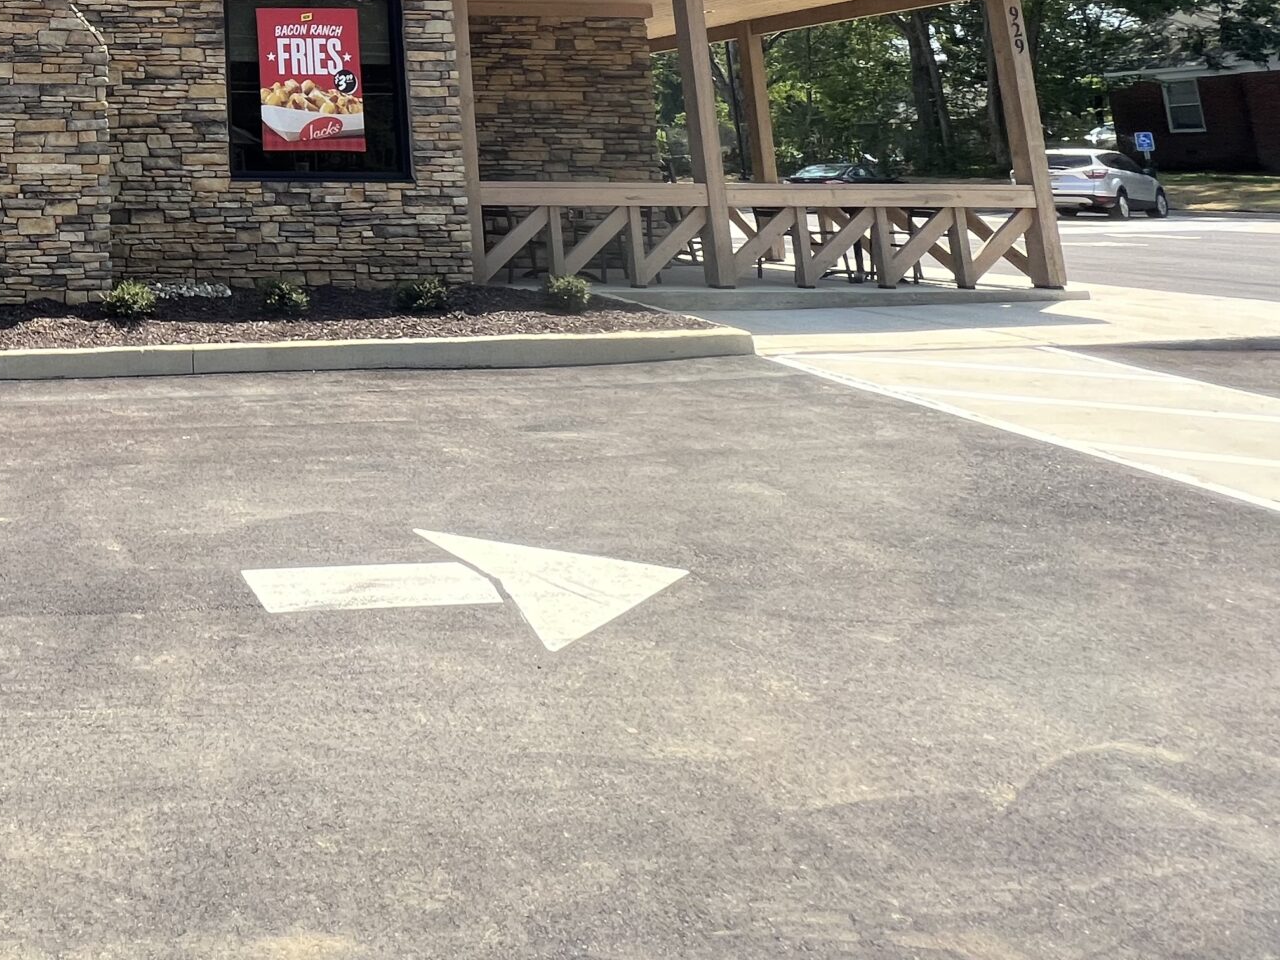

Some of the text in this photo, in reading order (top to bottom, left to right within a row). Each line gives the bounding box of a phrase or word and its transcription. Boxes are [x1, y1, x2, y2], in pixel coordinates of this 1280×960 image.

[274, 23, 343, 37] BACON RANCH
[1009, 6, 1024, 54] 929
[276, 37, 344, 75] FRIES
